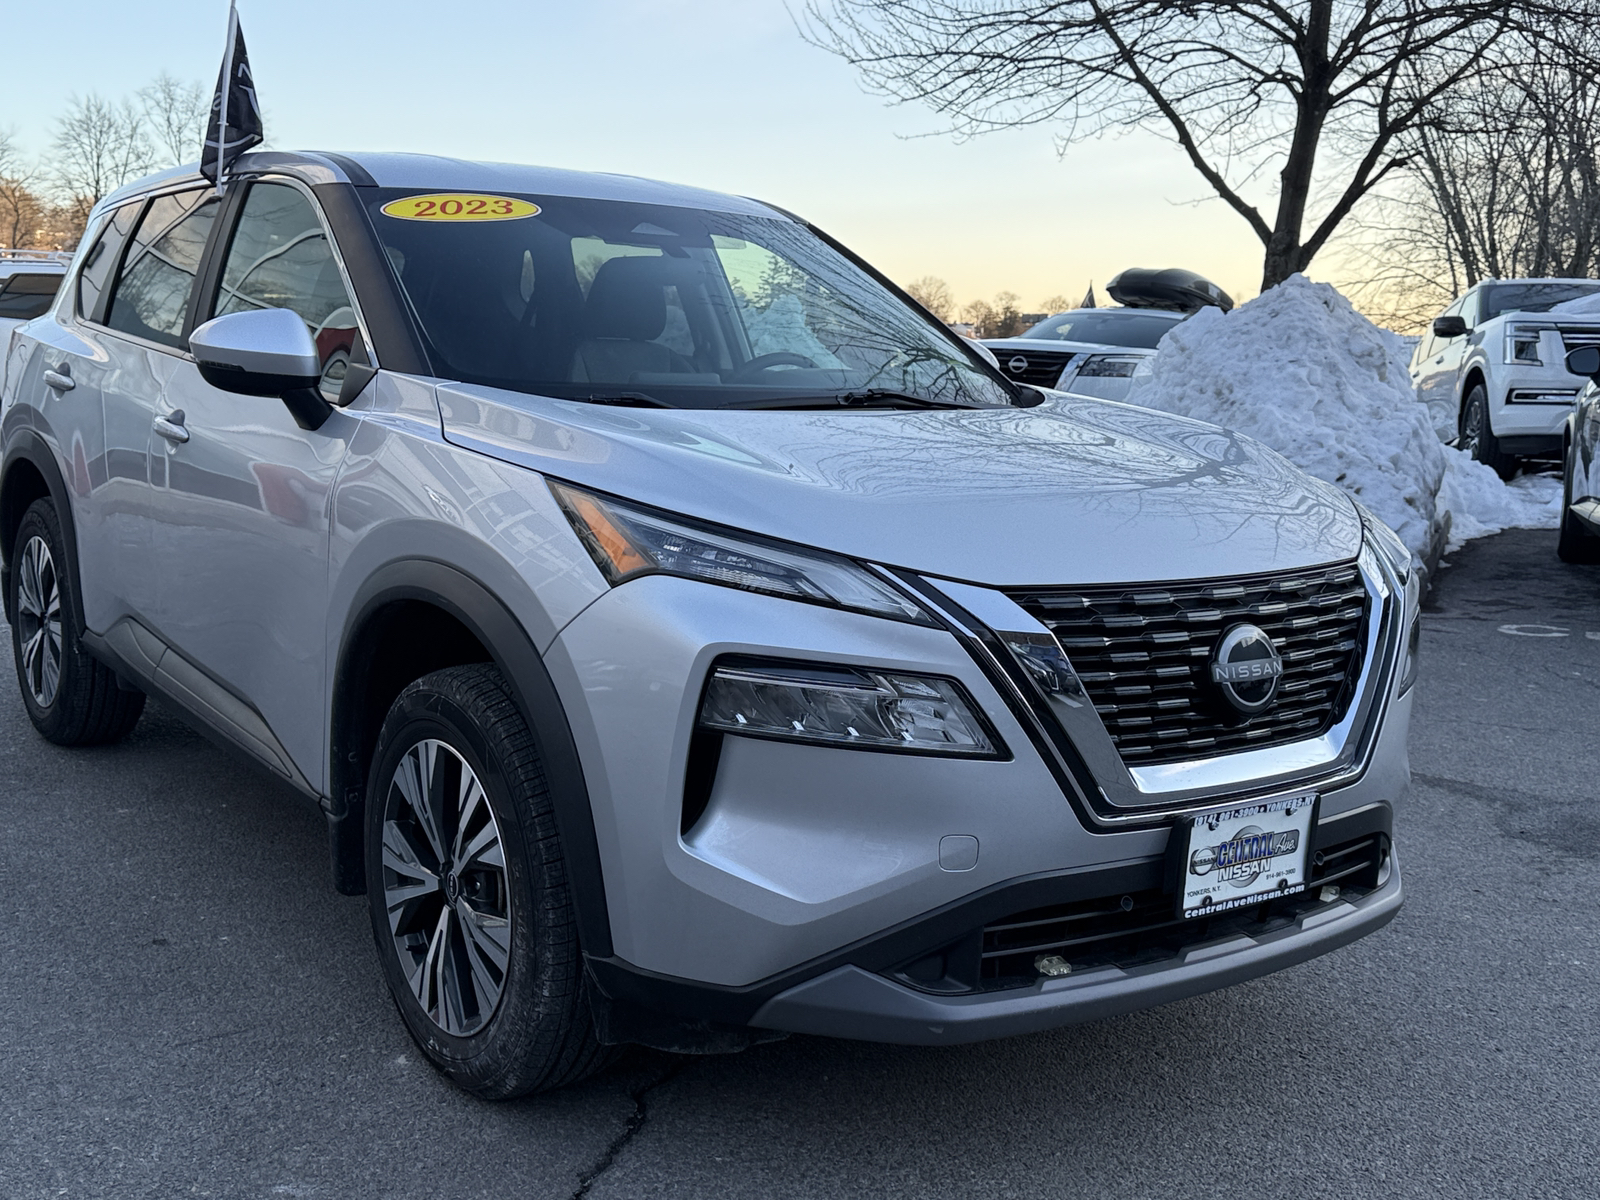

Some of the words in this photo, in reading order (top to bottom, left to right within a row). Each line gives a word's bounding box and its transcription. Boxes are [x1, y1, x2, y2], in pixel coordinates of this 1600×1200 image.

[414, 199, 514, 217] 2023
[1215, 661, 1282, 680] NISSAN
[1217, 832, 1274, 867] CENTRAL
[1217, 858, 1272, 882] NISSAN
